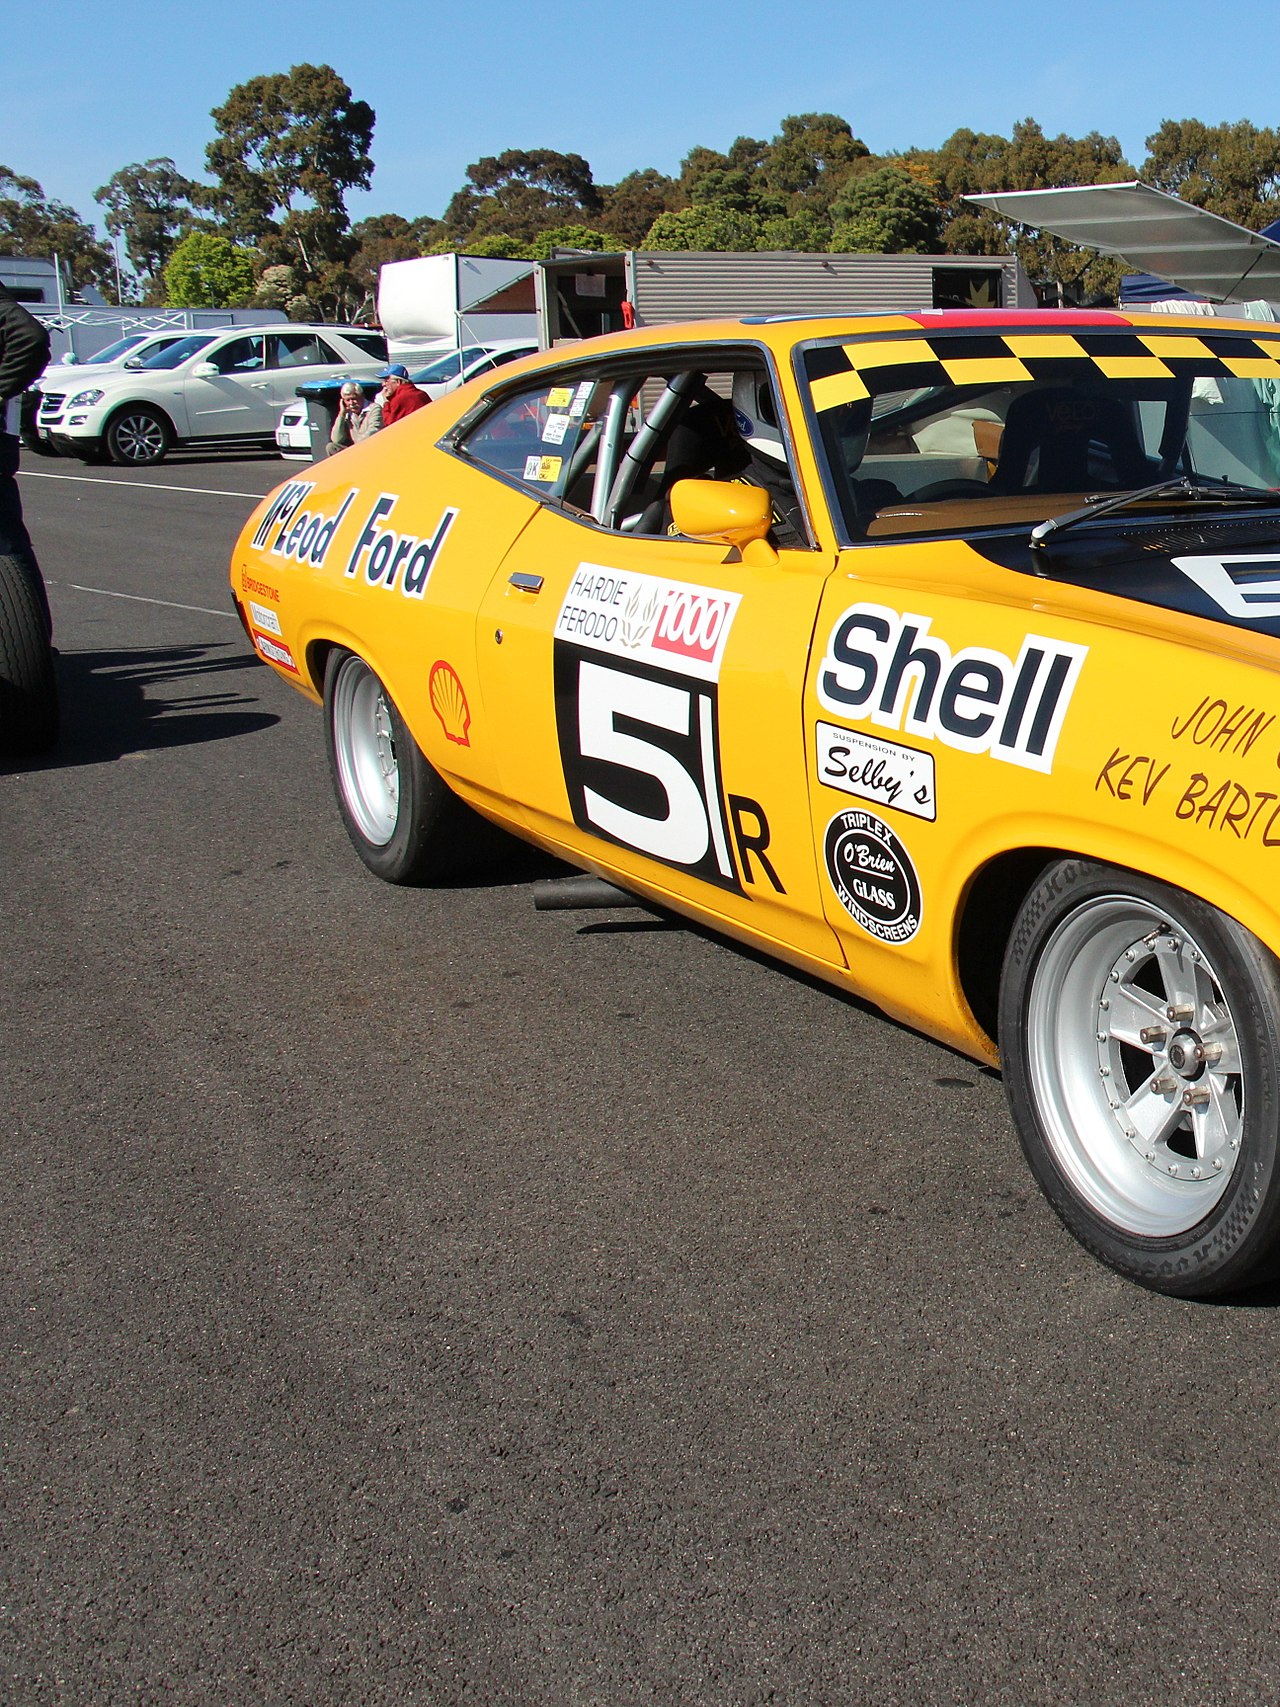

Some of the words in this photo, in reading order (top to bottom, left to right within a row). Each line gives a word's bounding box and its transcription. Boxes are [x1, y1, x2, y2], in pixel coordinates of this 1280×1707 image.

[347, 495, 456, 597] Ford
[559, 606, 618, 642] FERODO
[570, 572, 628, 606] HARDIE
[658, 592, 723, 650] 1000
[822, 612, 1074, 757] Shell
[832, 732, 897, 757] SUSPENSION
[901, 752, 916, 763] BY
[1171, 695, 1277, 760] JOHN
[577, 659, 735, 879] 51
[727, 793, 788, 895] R
[823, 746, 932, 804] Selby's
[1095, 748, 1171, 808] KEV
[840, 812, 894, 846] TRIPLEX
[843, 844, 897, 874] O'Brien
[836, 889, 919, 941] WINDSCREENS
[852, 878, 896, 911] GLASS
